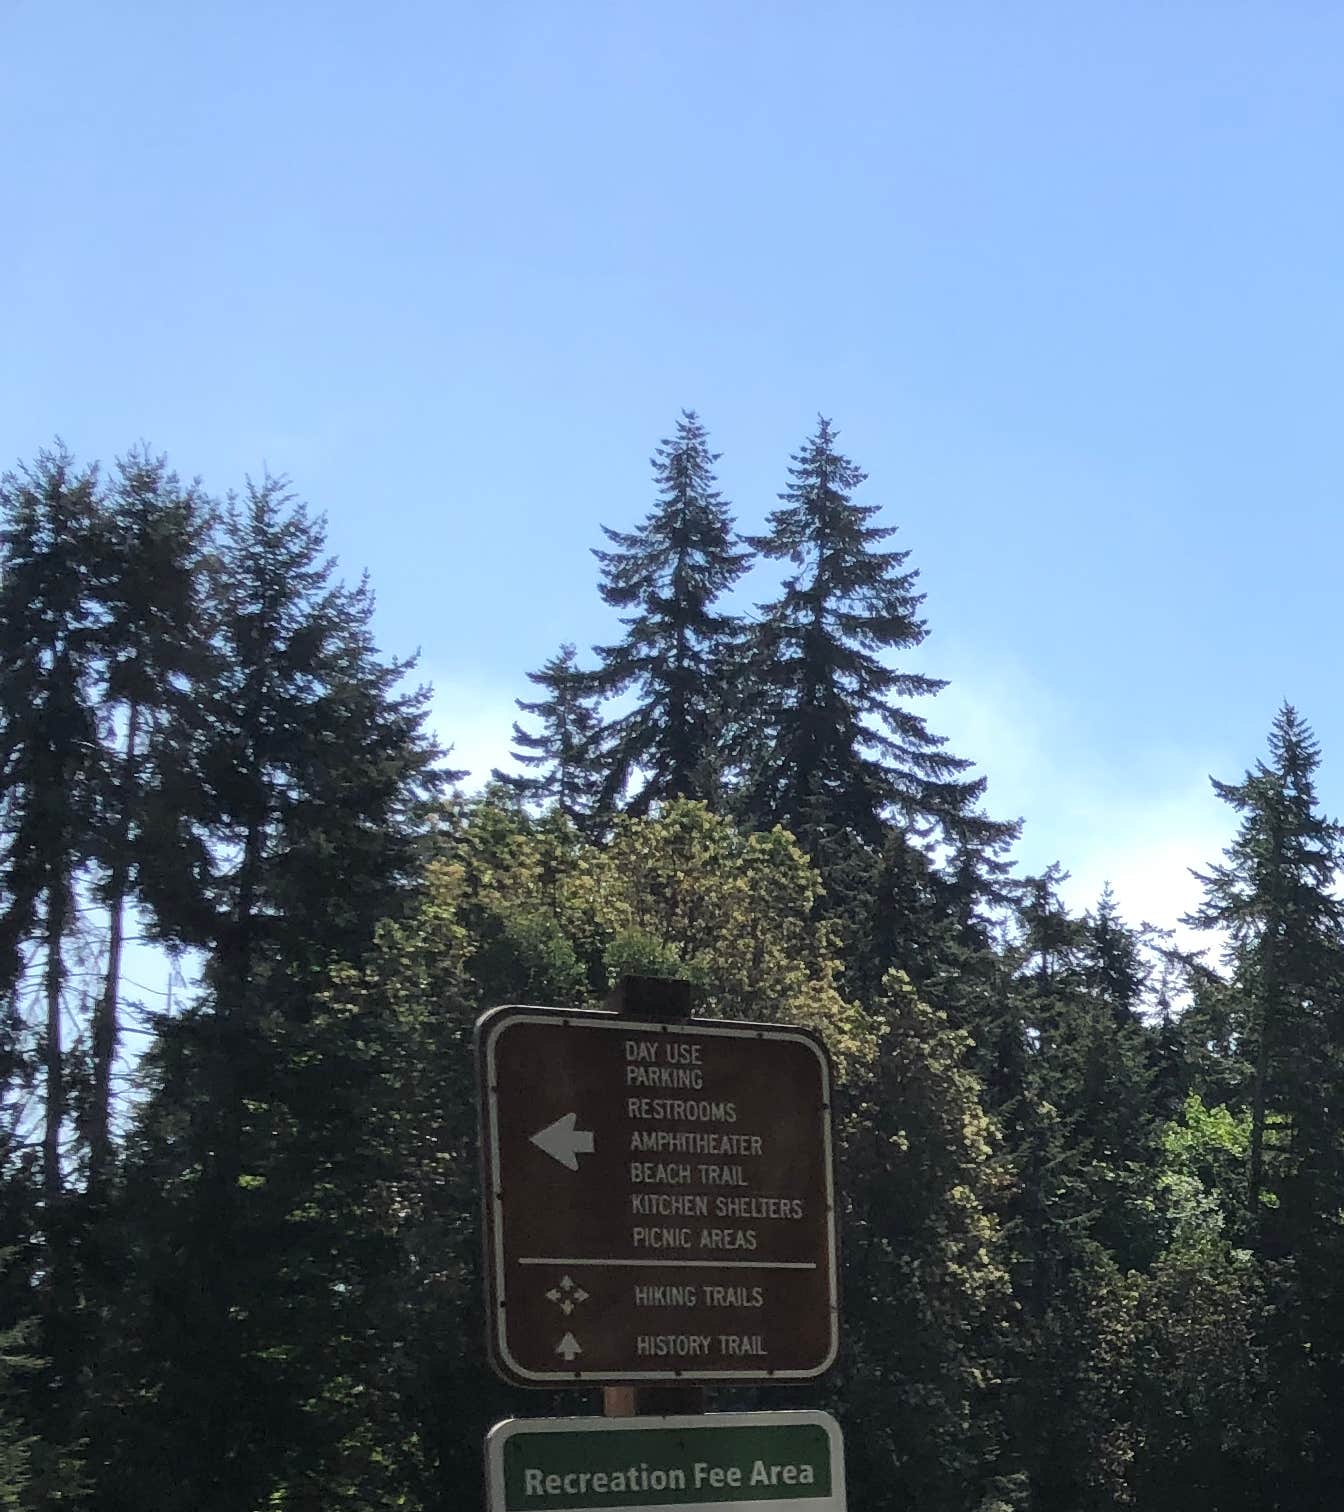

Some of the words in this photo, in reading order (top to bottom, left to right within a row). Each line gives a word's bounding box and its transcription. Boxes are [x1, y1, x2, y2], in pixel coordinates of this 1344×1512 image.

[626, 1040, 657, 1061] DAY
[665, 1044, 702, 1064] USE
[626, 1067, 703, 1089] PARKING
[628, 1098, 737, 1121] RESTROOMS
[631, 1131, 763, 1156] AMPHITHEATER
[631, 1163, 691, 1184] BEACH
[700, 1165, 749, 1186] TRAIL
[632, 1195, 708, 1217] KITCHEN
[716, 1197, 803, 1219] SHELTERS
[633, 1227, 692, 1248] PICNIC
[700, 1229, 757, 1251] AREAS
[635, 1286, 696, 1307] HIKING
[704, 1286, 764, 1307] TRAILS
[637, 1335, 712, 1356] HISTORY
[720, 1336, 768, 1356] TRAIL
[524, 1463, 686, 1496] Recreation
[693, 1462, 741, 1489] Fee
[750, 1460, 815, 1487] Area
